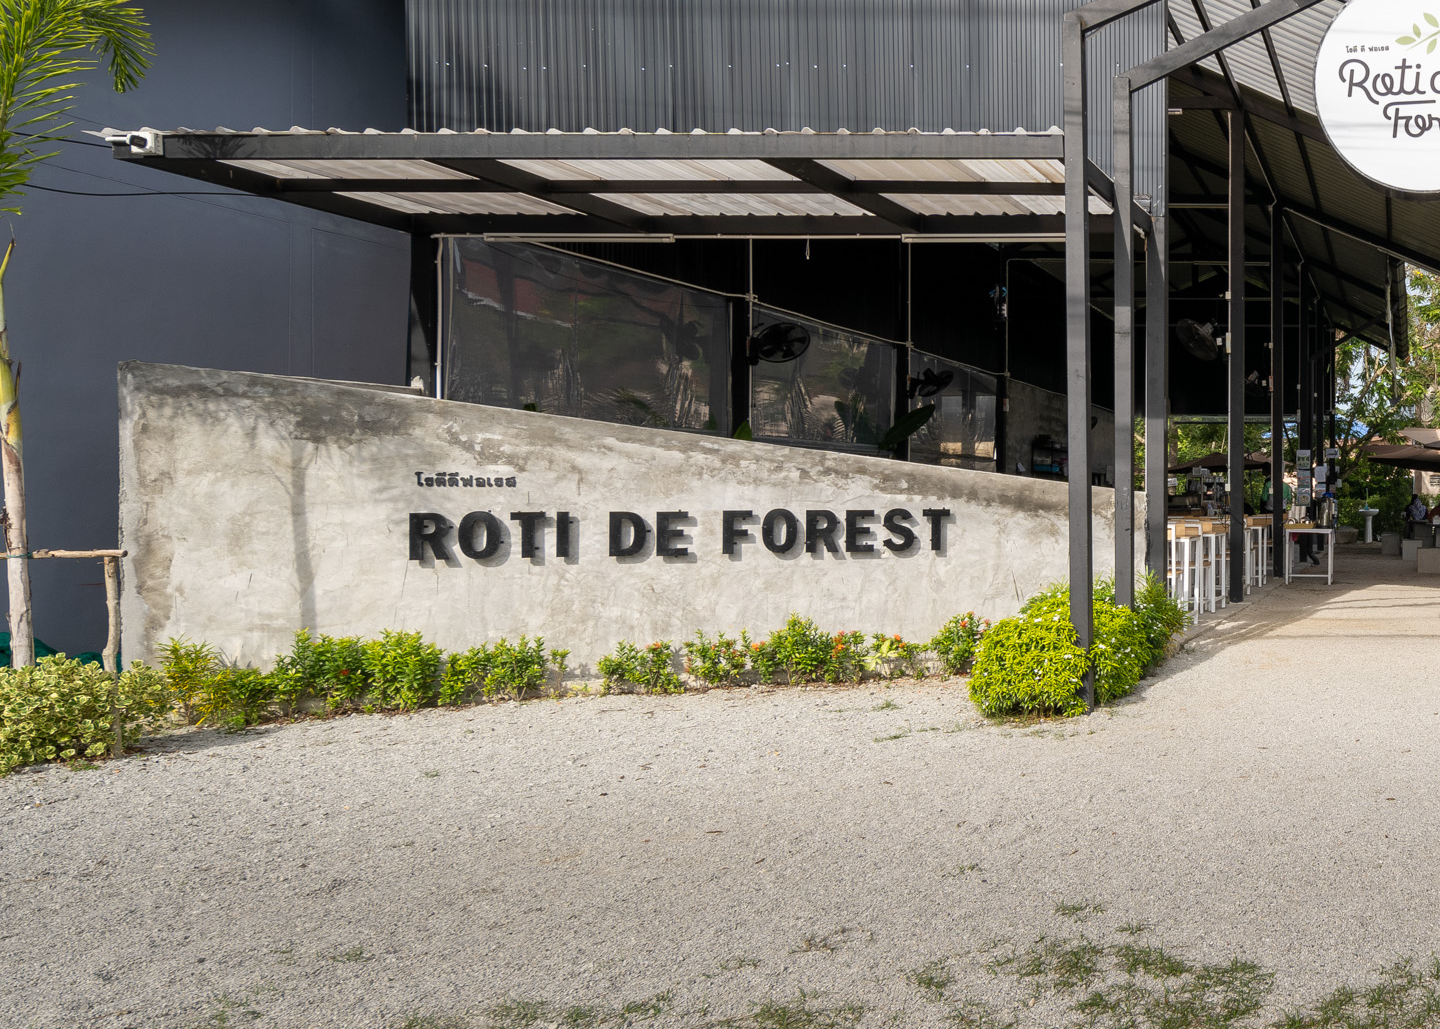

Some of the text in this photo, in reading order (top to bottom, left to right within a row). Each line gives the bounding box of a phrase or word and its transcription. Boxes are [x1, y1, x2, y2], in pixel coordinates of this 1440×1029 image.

[1338, 58, 1426, 105] Roti
[408, 507, 951, 561] ROTI DE FOREST
